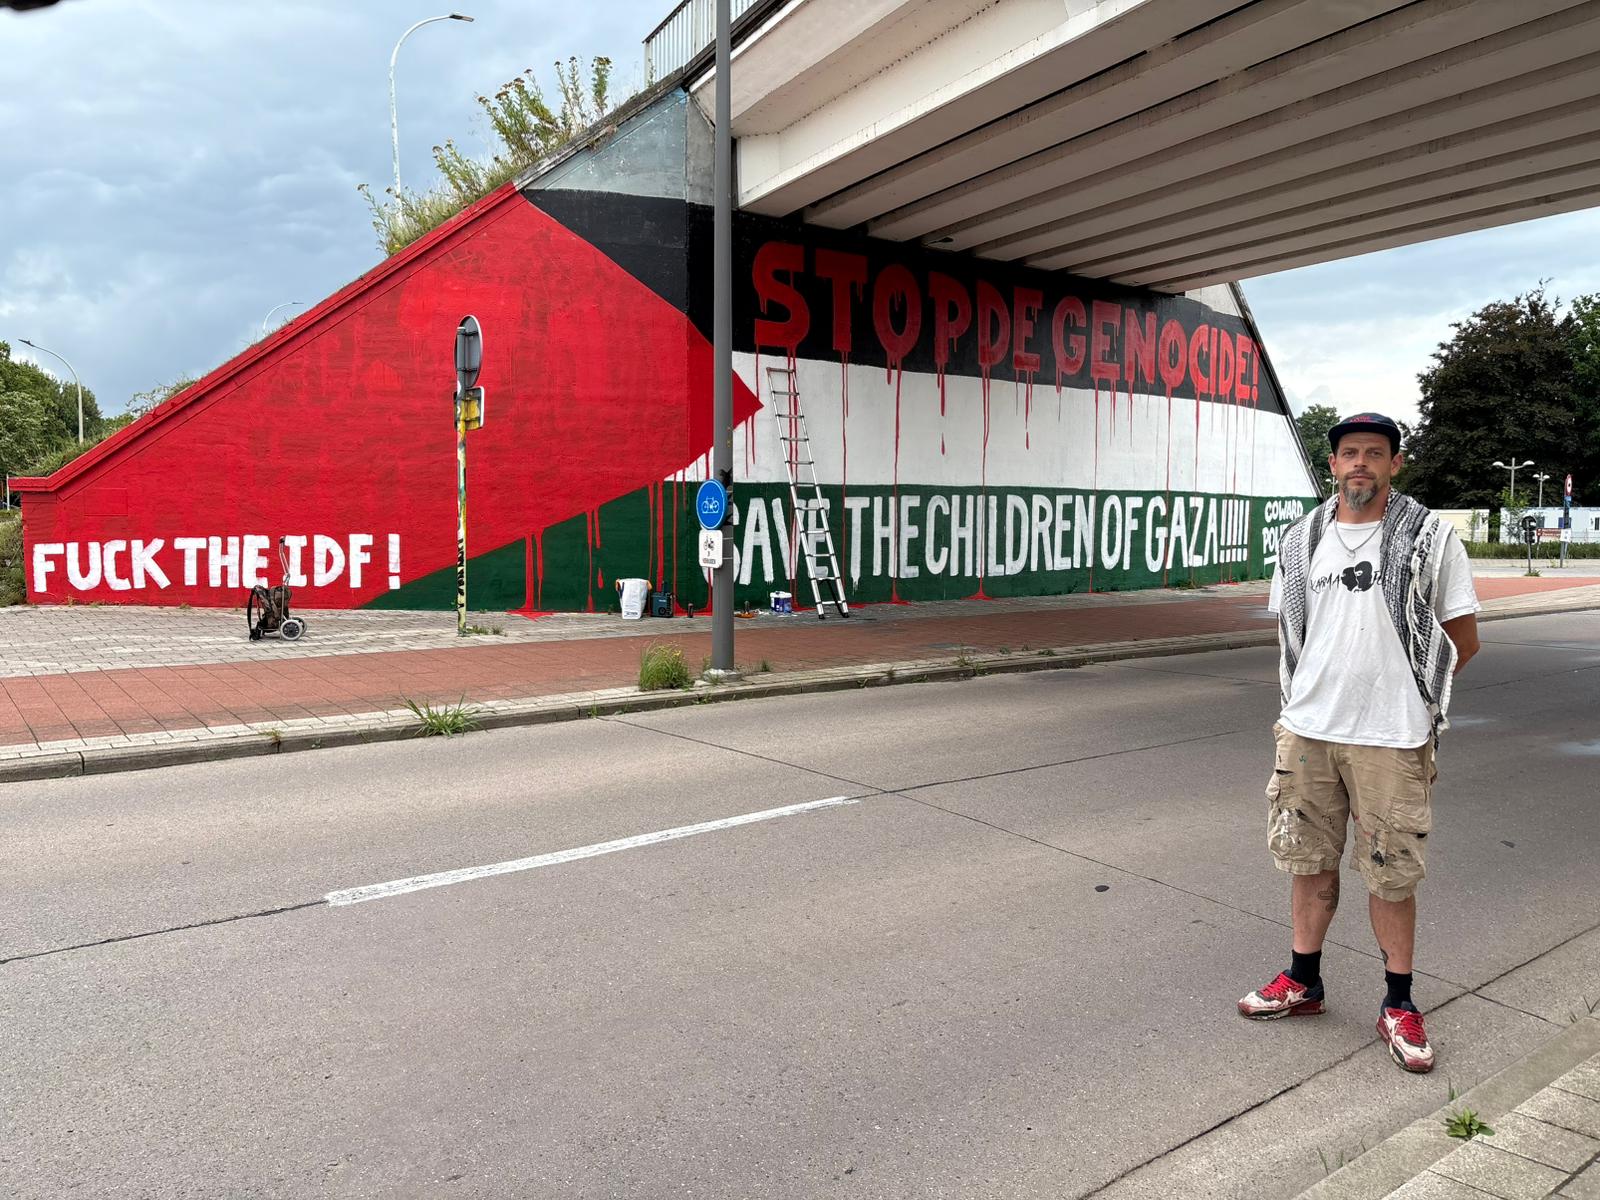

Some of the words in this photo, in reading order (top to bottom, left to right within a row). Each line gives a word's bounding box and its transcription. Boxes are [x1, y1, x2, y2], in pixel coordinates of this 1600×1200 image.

[752, 241, 971, 364] STOP
[977, 278, 1042, 371] DE
[1052, 296, 1259, 400] GENOCIDE!
[845, 495, 920, 582] THE
[924, 493, 1096, 578] CHILDREN
[1101, 495, 1143, 570] OF
[1264, 499, 1304, 523] COWARD
[33, 538, 171, 593] FUCK
[173, 535, 270, 588] THE
[283, 533, 373, 589] IDF
